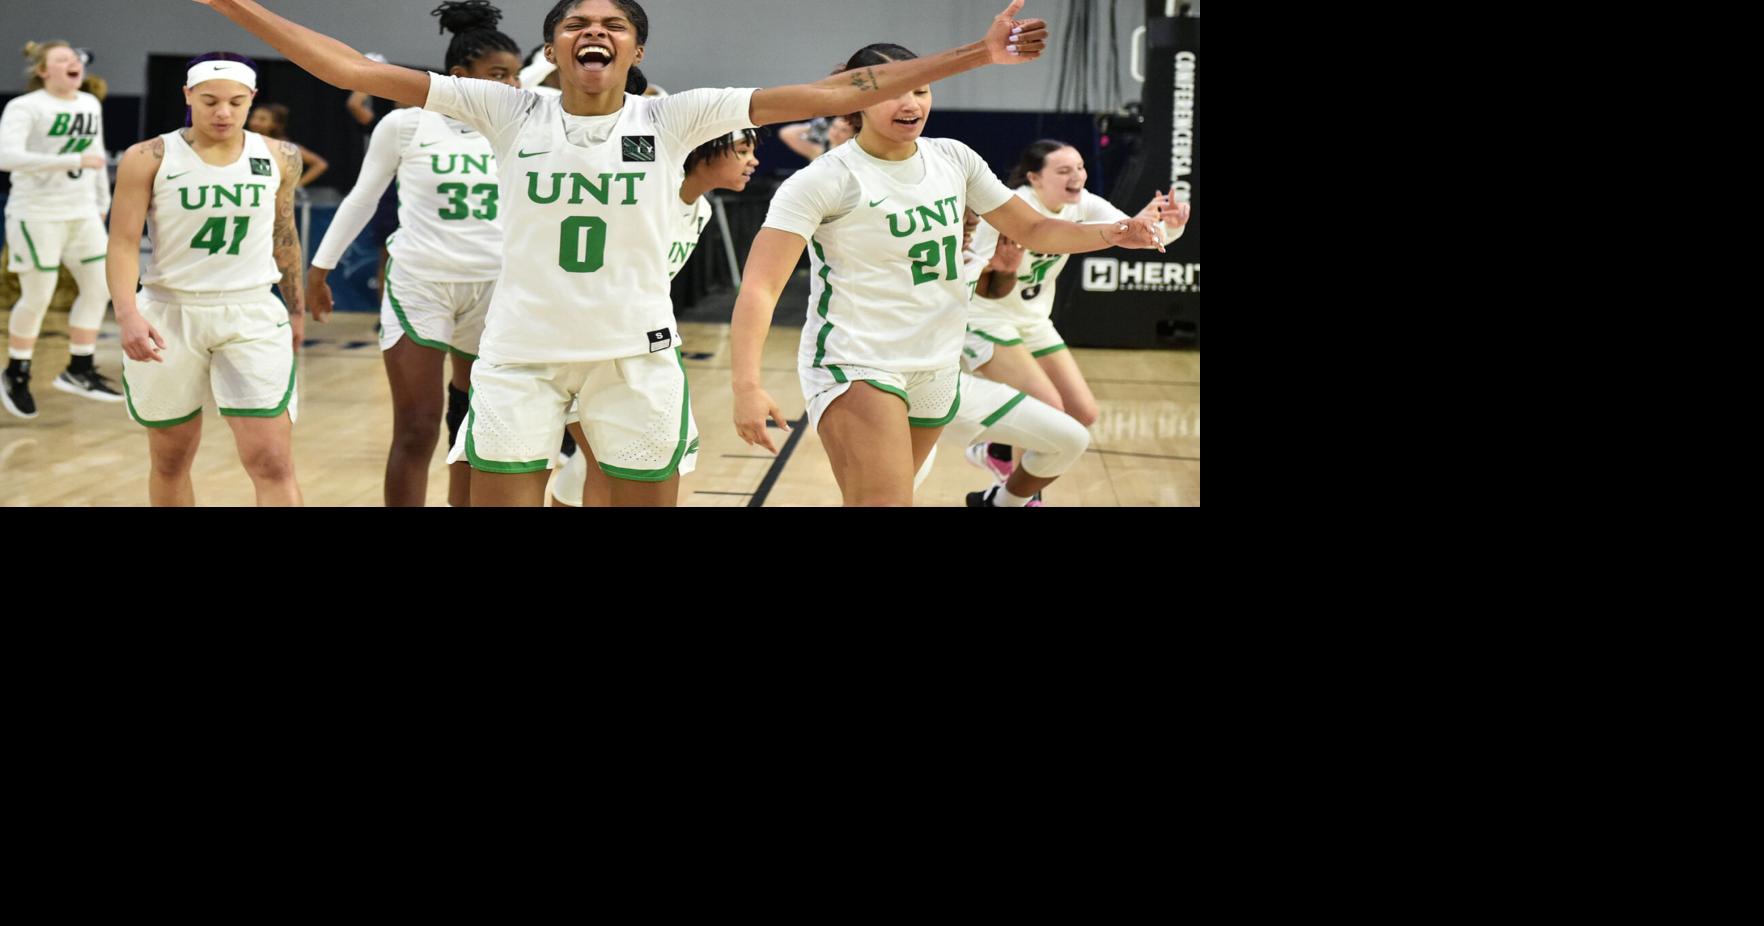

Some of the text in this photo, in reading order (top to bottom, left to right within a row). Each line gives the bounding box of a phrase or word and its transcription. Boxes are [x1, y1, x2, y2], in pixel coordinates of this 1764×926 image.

[1171, 51, 1196, 203] CONFERENCEUSA.CO
[430, 154, 495, 174] UN
[178, 184, 266, 210] UNT
[437, 182, 499, 221] 33
[525, 171, 646, 205] UNT
[190, 216, 251, 256] 41
[886, 196, 959, 238] UNT
[559, 215, 607, 273] 0
[908, 235, 958, 286] 21
